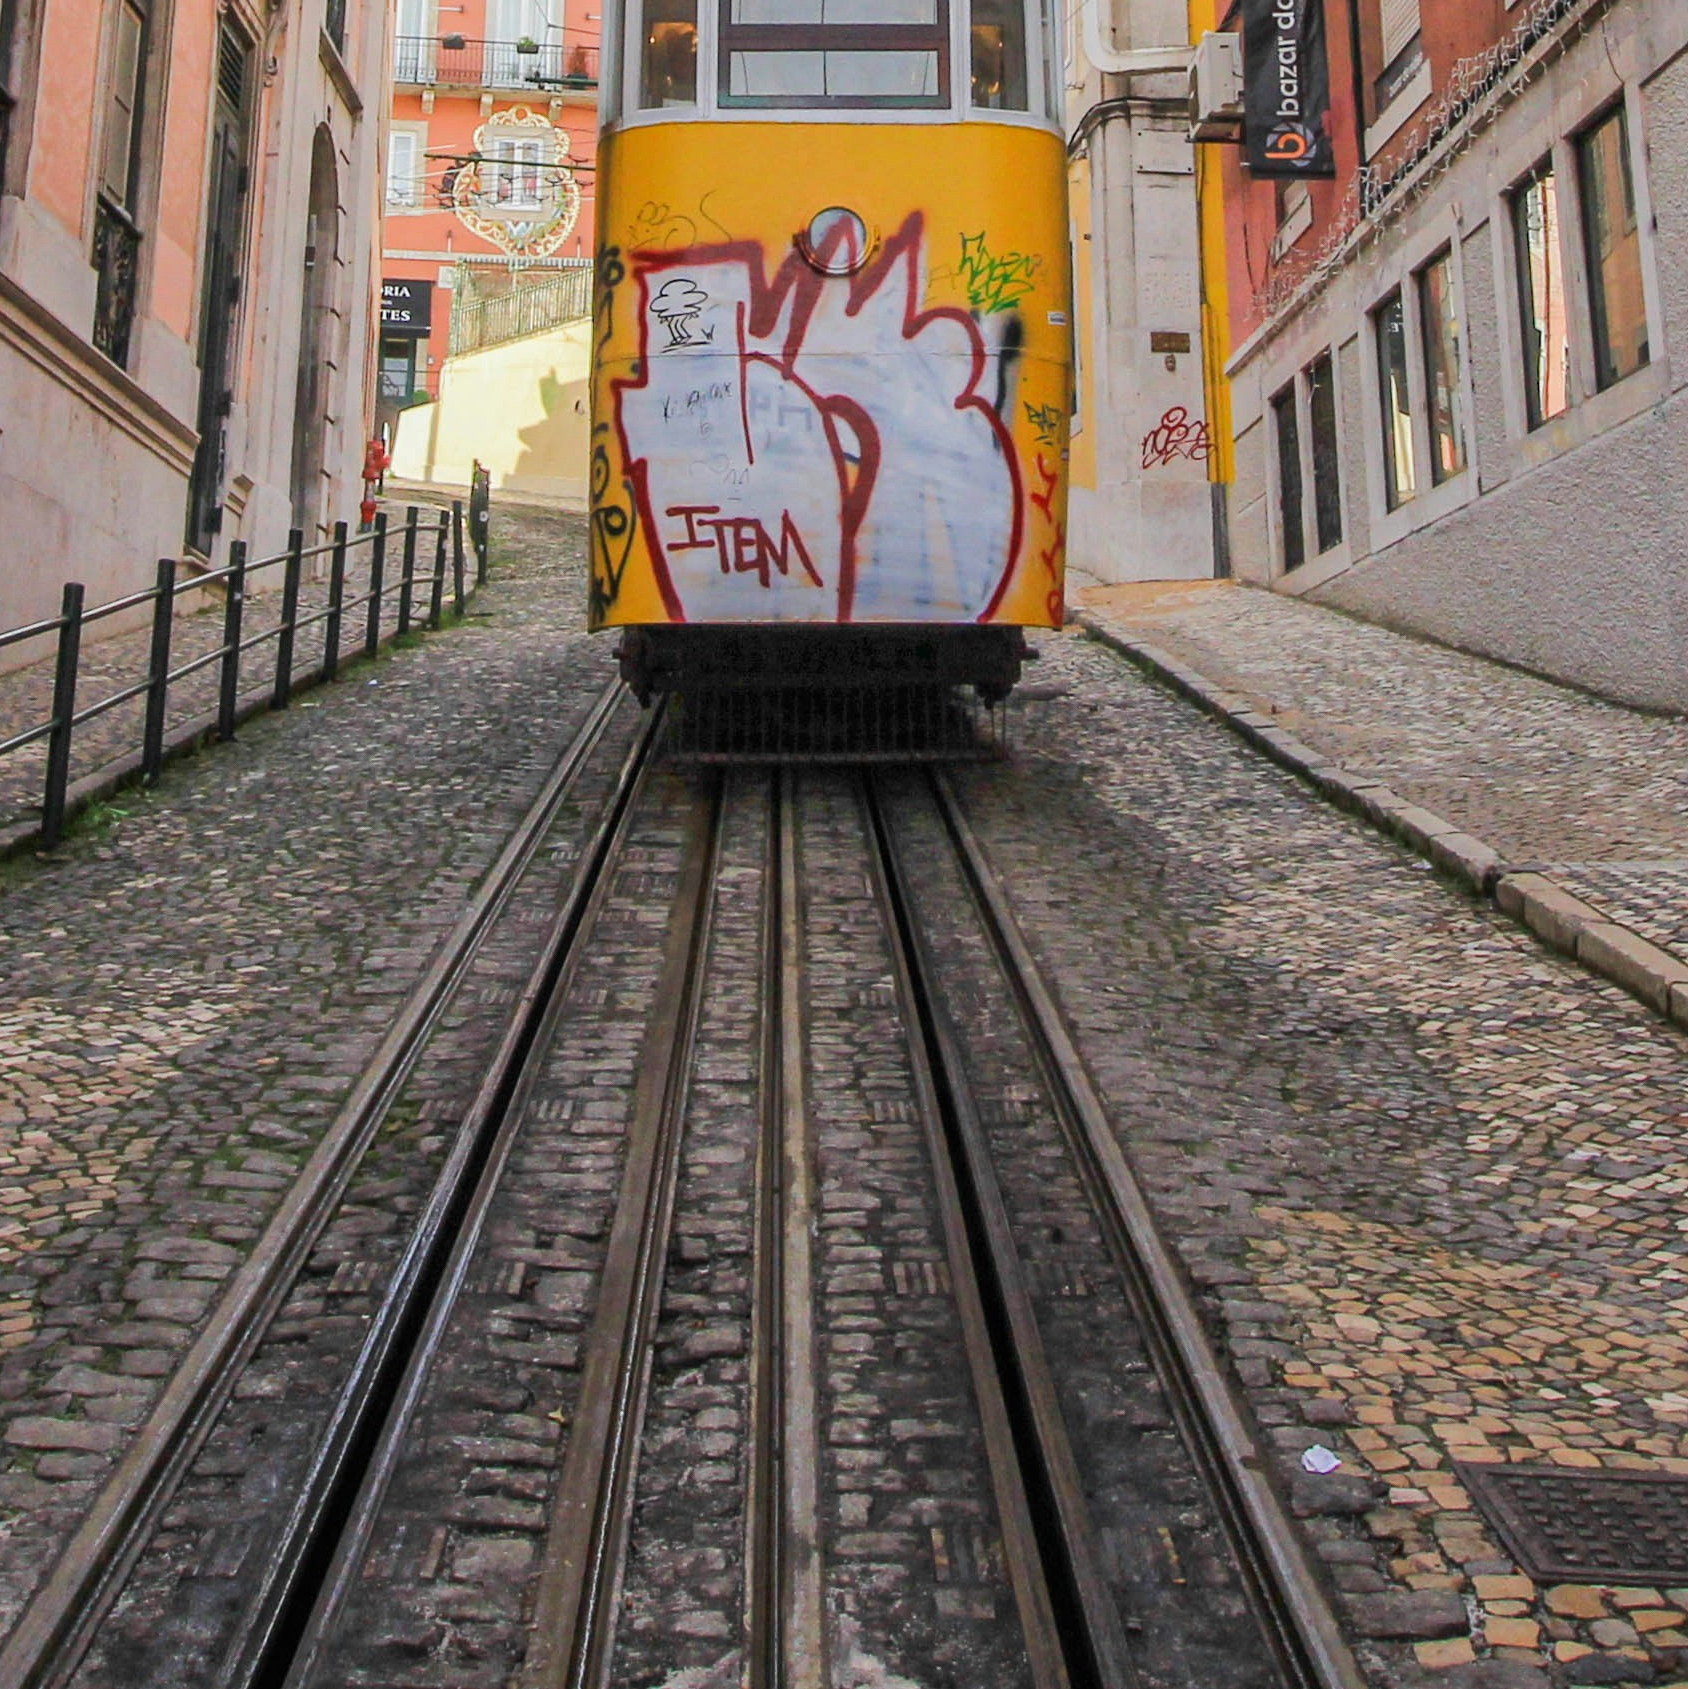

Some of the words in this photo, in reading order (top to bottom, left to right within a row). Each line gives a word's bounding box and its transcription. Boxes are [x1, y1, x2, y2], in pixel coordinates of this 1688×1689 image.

[1276, 36, 1300, 116] bazar
[380, 285, 411, 297] RIA
[380, 309, 411, 322] TES
[665, 505, 824, 589] ITEM
